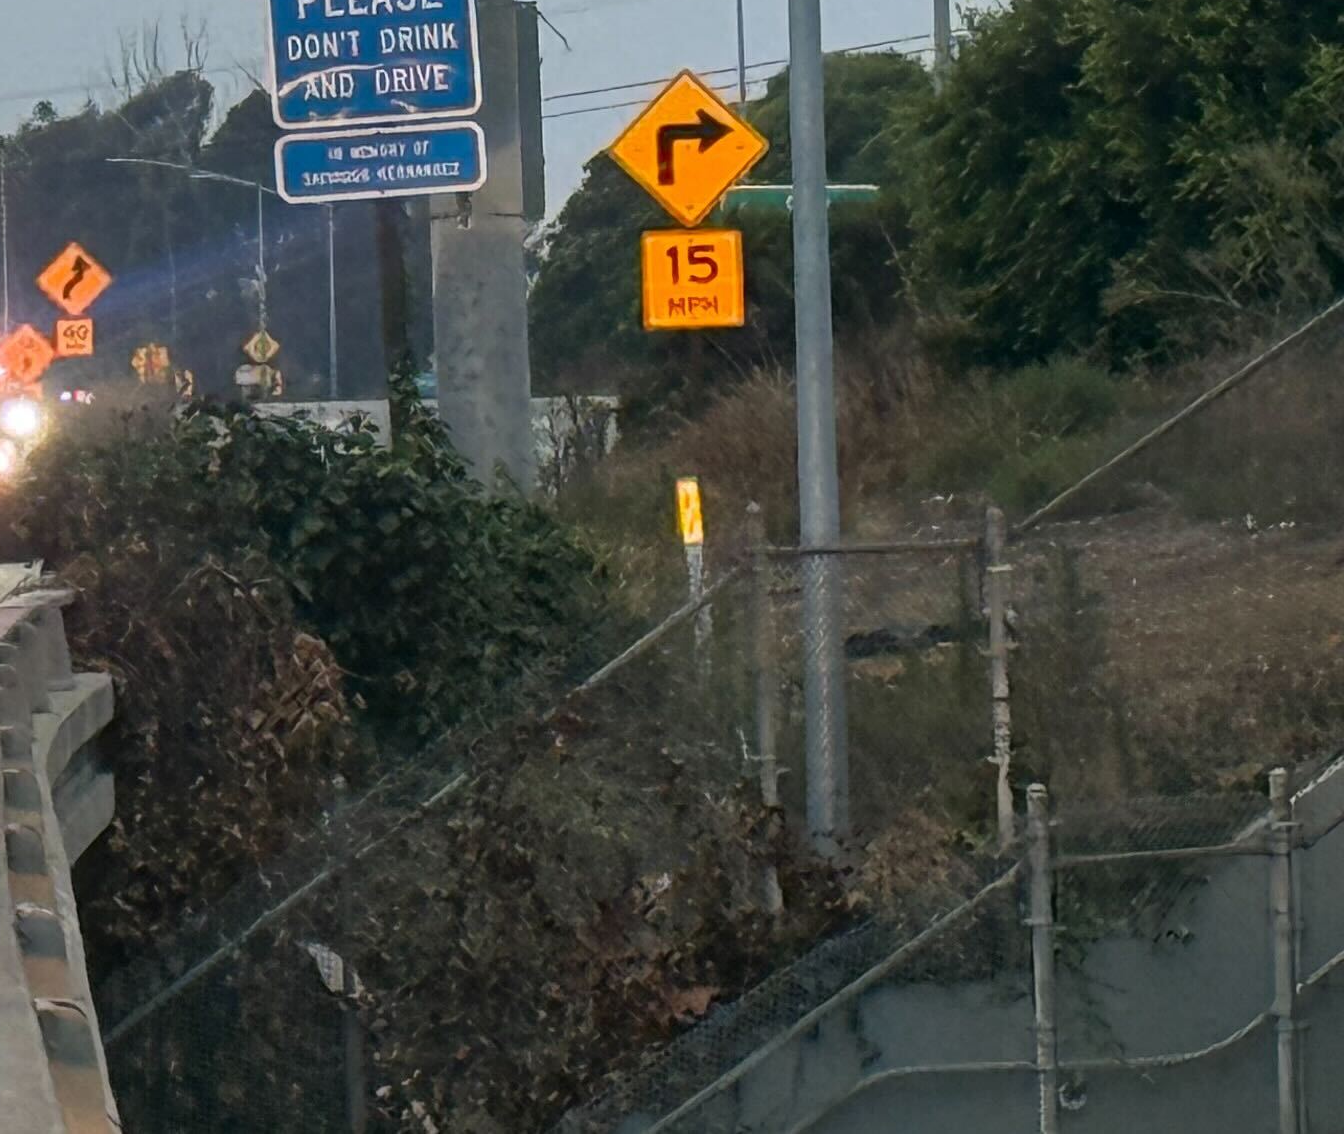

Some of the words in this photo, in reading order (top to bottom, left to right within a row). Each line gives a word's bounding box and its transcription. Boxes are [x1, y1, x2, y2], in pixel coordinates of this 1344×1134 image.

[287, 29, 360, 61] DON'T
[380, 23, 459, 54] DRINK
[304, 72, 354, 101] AND
[375, 64, 450, 94] DRIVE
[666, 244, 719, 285] 15
